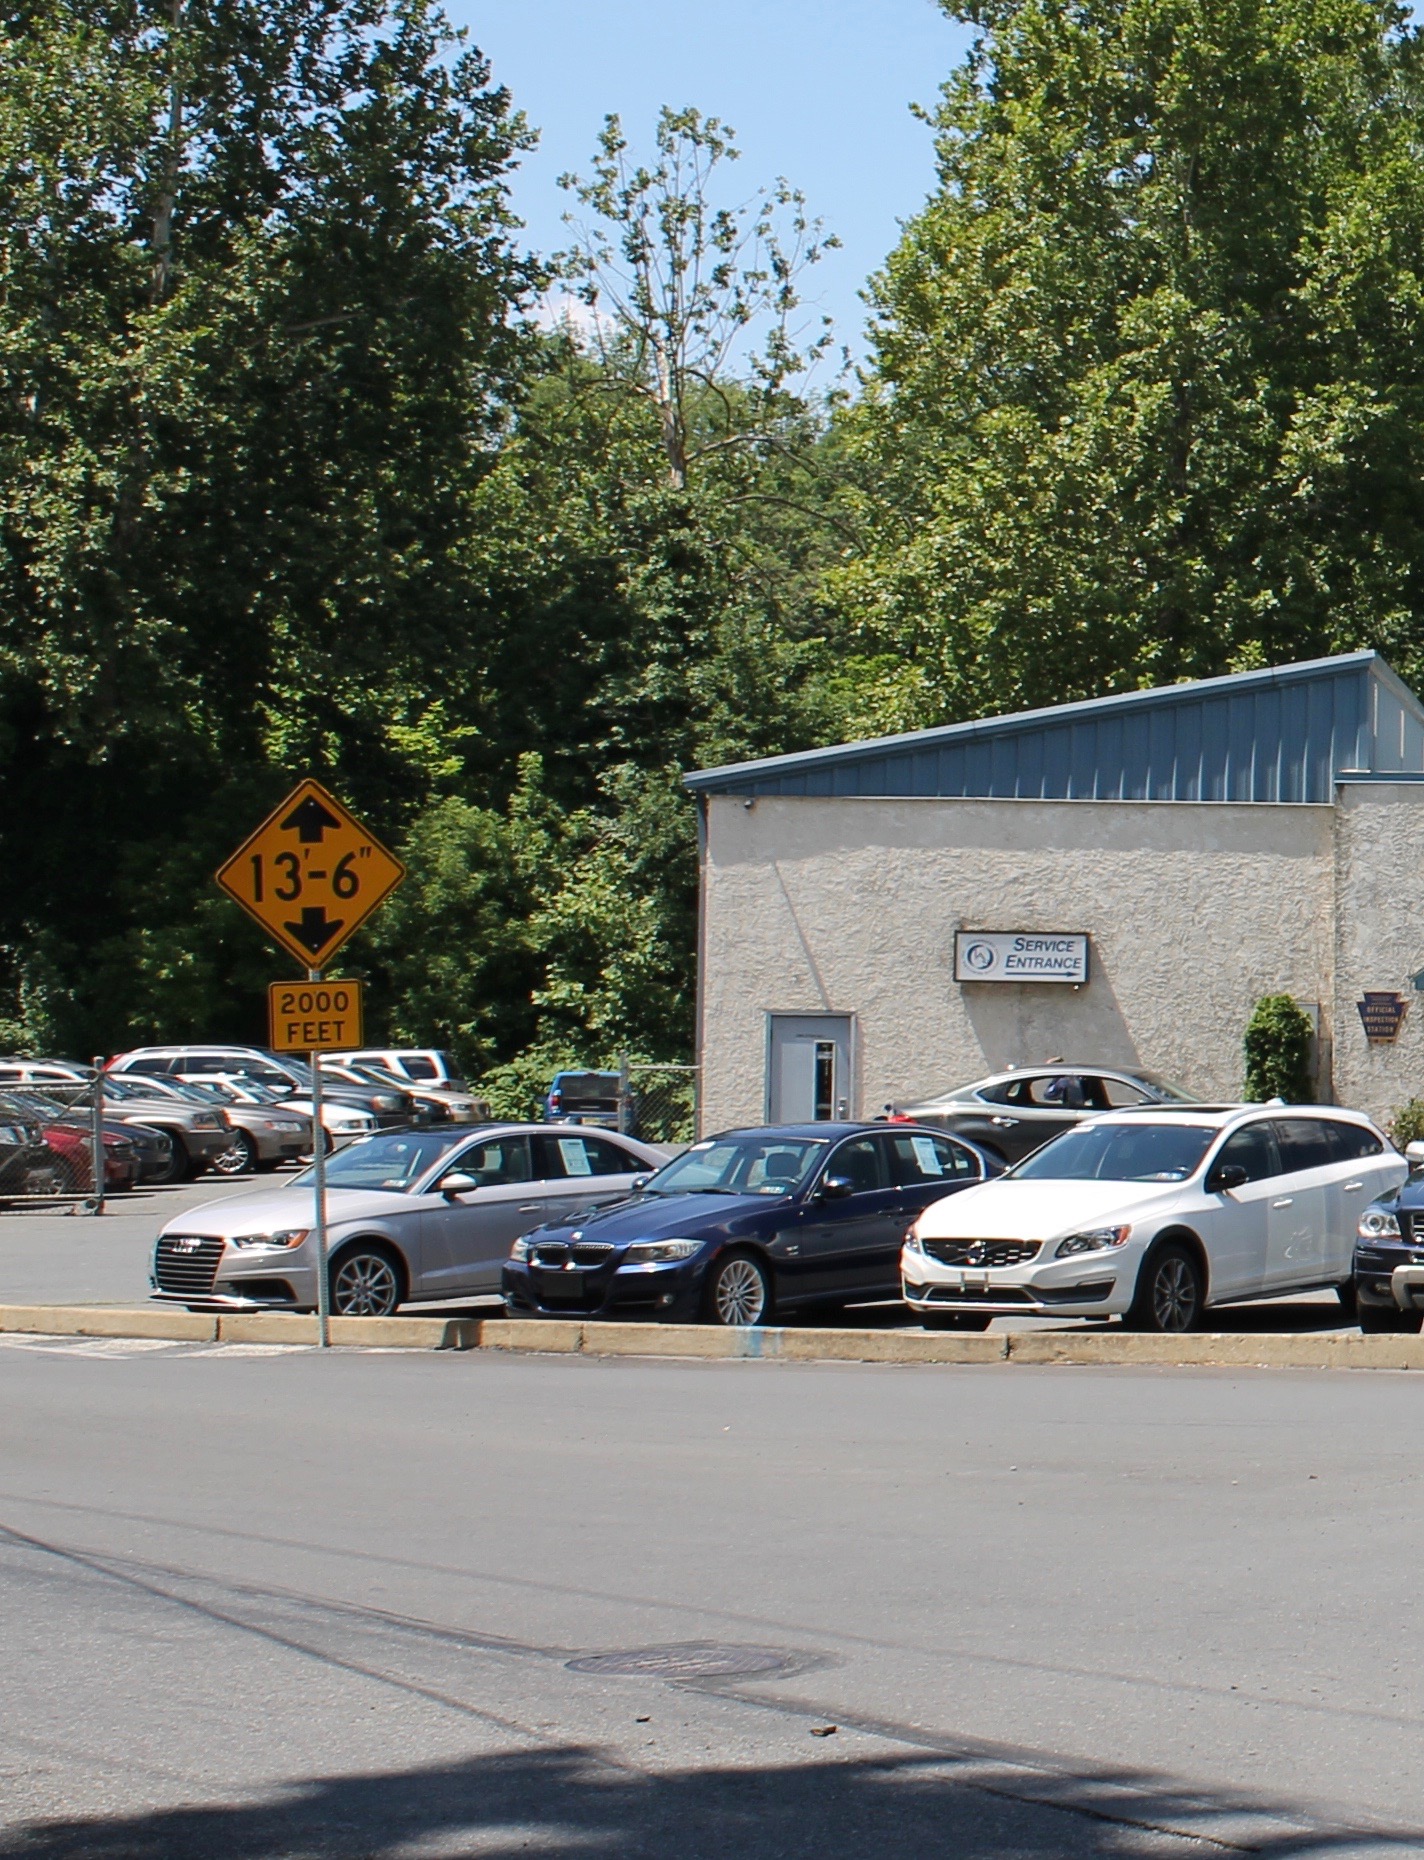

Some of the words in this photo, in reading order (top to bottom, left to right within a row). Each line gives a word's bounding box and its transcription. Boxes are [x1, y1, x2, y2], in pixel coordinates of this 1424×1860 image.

[1014, 937, 1075, 952] SERVICE
[1005, 955, 1082, 969] ENTRANCE
[281, 991, 349, 1015] 2000
[287, 1020, 346, 1043] FEET
